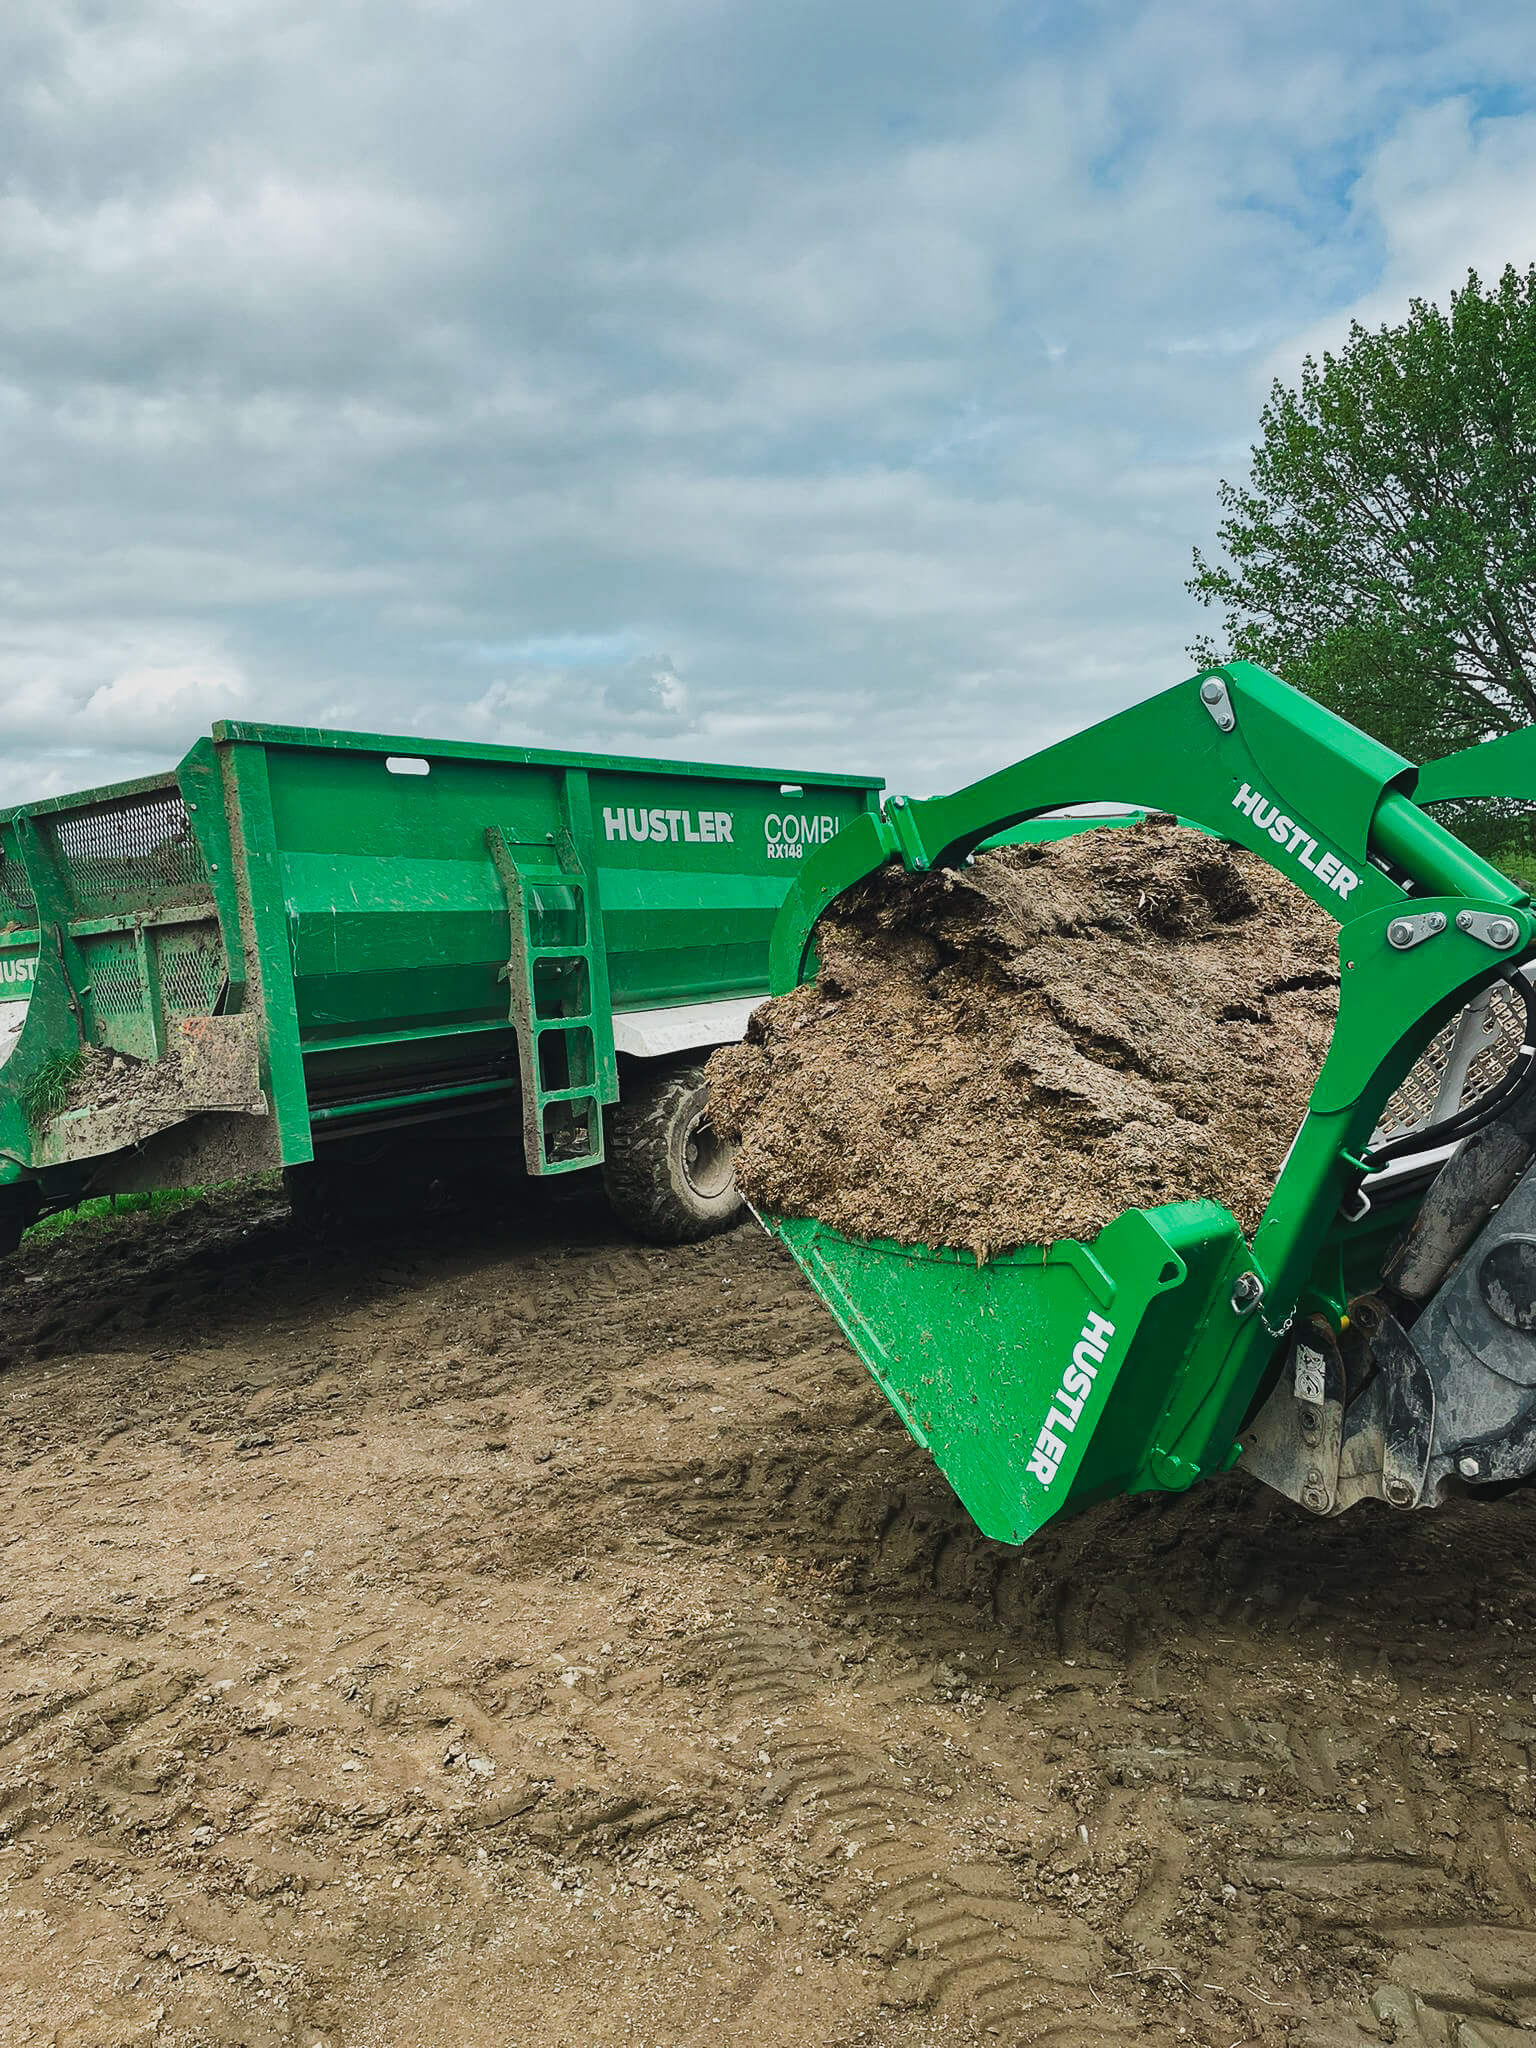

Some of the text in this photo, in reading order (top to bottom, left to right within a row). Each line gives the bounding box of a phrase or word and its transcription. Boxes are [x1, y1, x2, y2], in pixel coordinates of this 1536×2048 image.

[602, 807, 734, 843] HUSTLER
[764, 813, 839, 844] COMBI
[1231, 782, 1360, 901] HUSTLER
[767, 843, 803, 859] RX148
[0, 957, 38, 984] UST
[1025, 1310, 1117, 1486] HUSTLER
